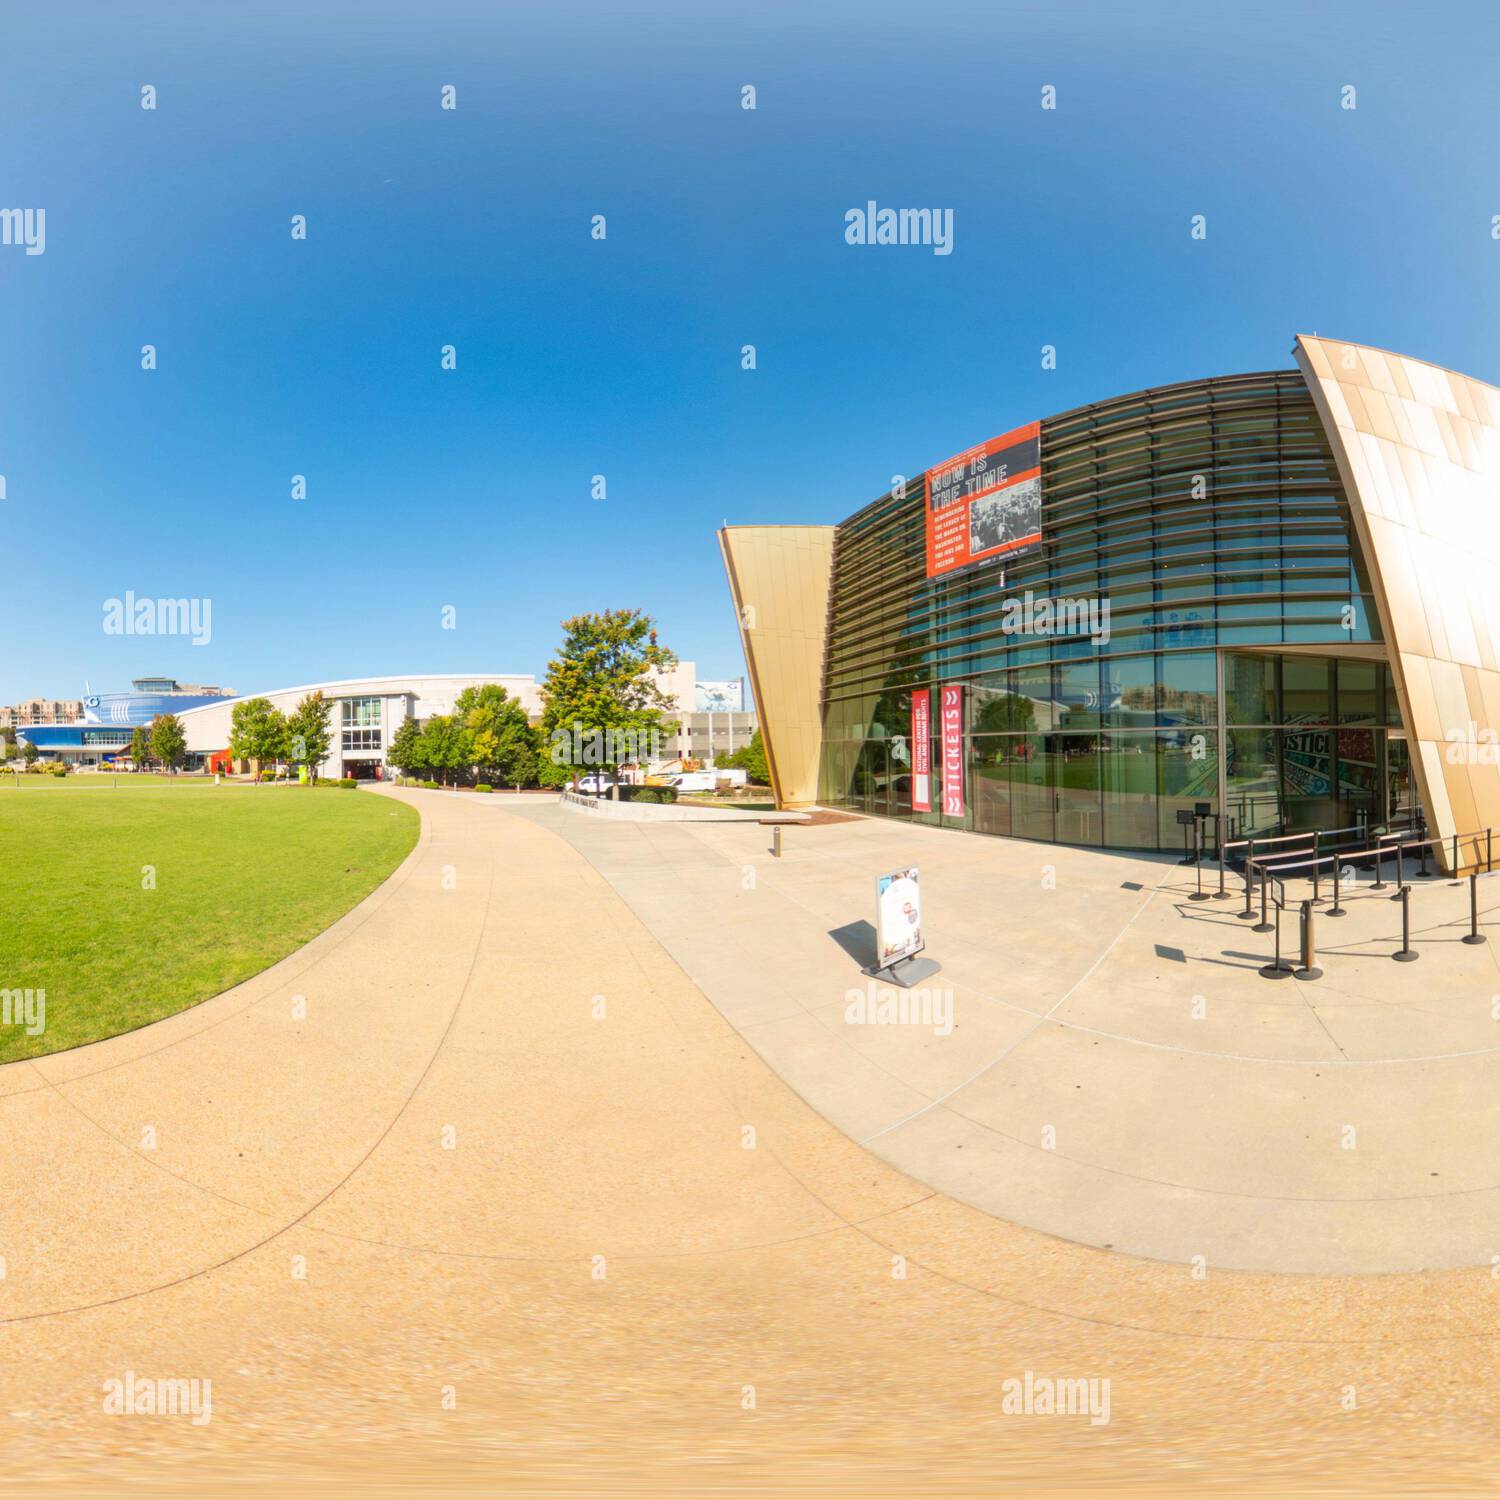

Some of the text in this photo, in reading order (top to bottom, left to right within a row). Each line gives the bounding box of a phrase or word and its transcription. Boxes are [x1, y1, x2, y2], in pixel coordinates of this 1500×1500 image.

[932, 463, 965, 493] NOW
[970, 453, 987, 475] IS
[932, 464, 1008, 512] THE TIME
[946, 710, 961, 791] TICKETS
